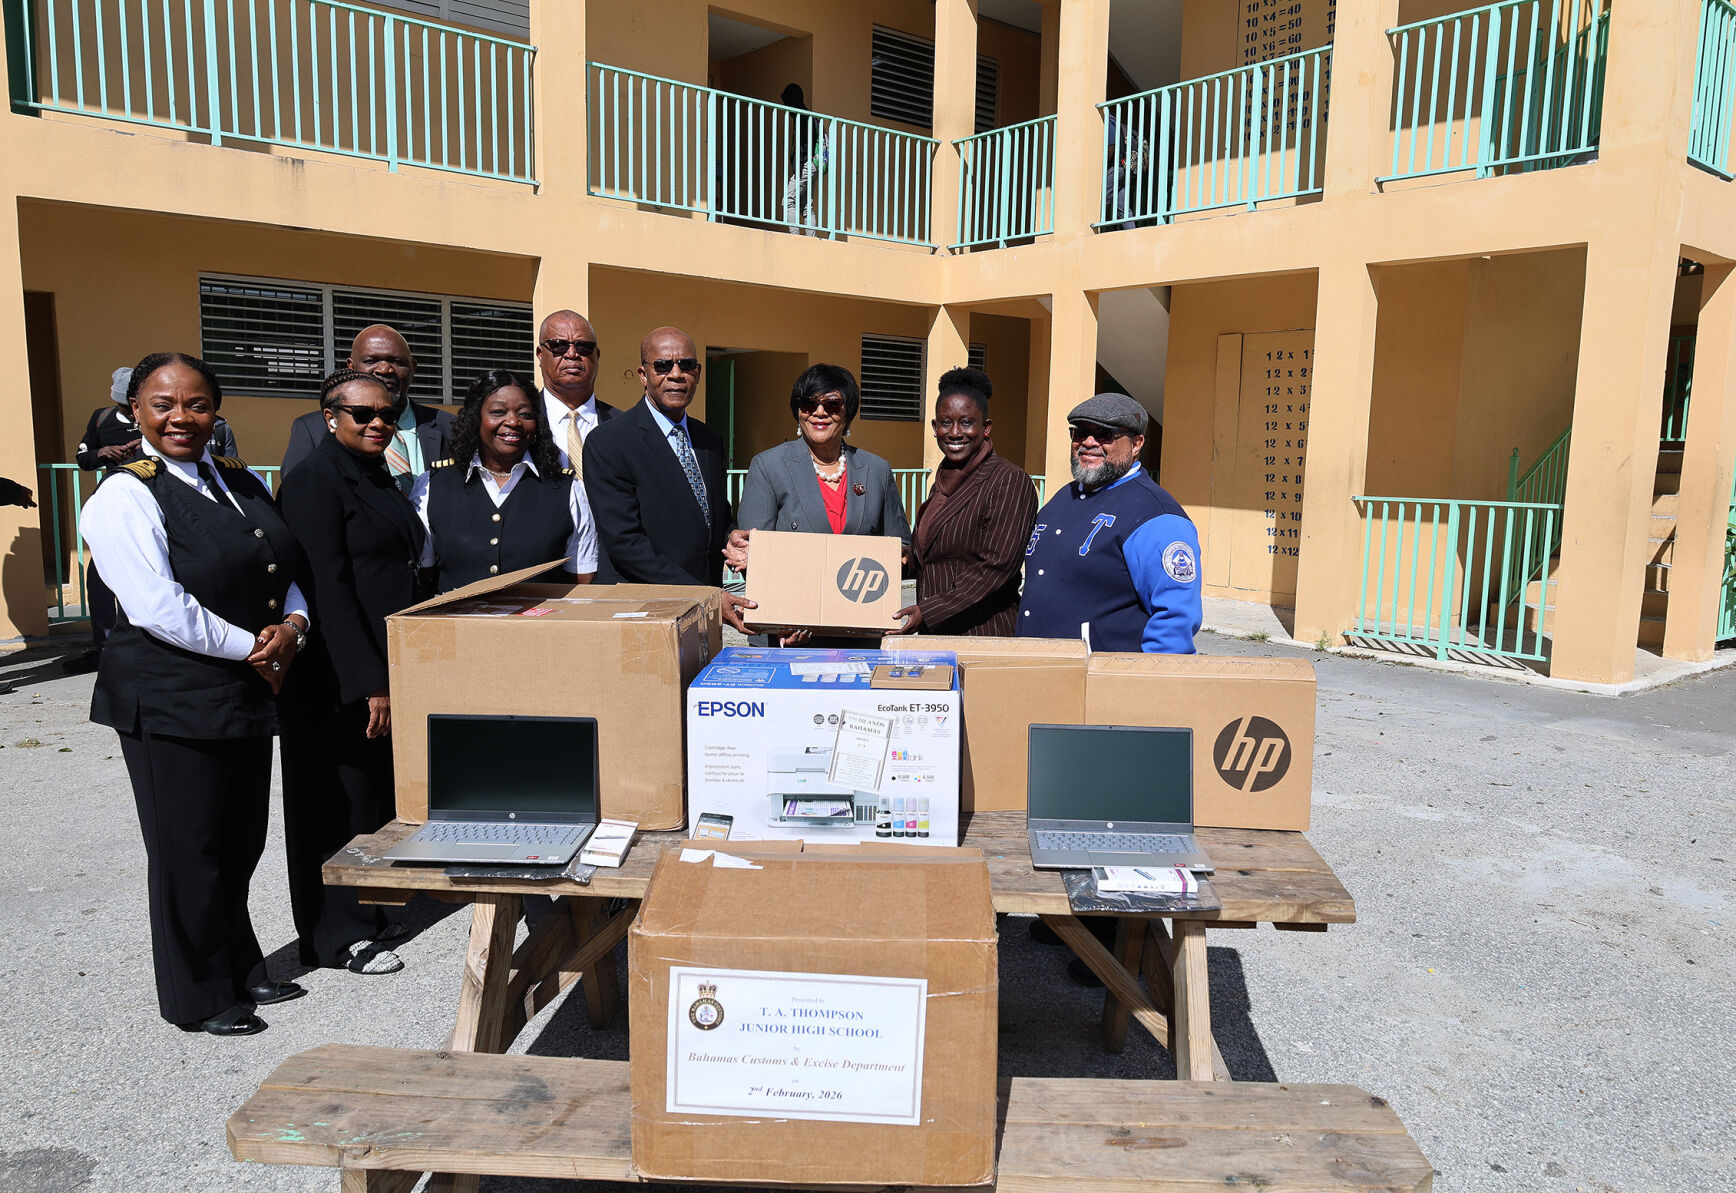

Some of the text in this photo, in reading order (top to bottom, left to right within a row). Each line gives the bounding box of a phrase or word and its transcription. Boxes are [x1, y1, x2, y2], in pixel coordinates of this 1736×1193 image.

[1246, 17, 1258, 28] 10
[1245, 32, 1258, 43] 10
[1244, 46, 1257, 58] 10
[1303, 349, 1309, 360] 1
[1266, 369, 1281, 379] 12
[1300, 367, 1307, 377] 2
[1266, 386, 1280, 396] 12
[1300, 385, 1306, 395] 3
[1265, 404, 1278, 414] 12
[1299, 403, 1306, 413] 4
[1265, 421, 1278, 431] 12
[1299, 421, 1305, 431] 5
[1264, 438, 1276, 448] 12
[1297, 439, 1304, 448] 6
[1264, 455, 1276, 465] 12
[1297, 456, 1304, 466] 7
[1264, 473, 1276, 482] 12
[1295, 474, 1302, 484] 8
[1264, 491, 1275, 500] 12
[1294, 492, 1302, 502] 9
[1264, 509, 1275, 519] 12
[1290, 511, 1302, 521] 10
[1079, 512, 1117, 557] T
[1266, 527, 1278, 536] 12
[1267, 544, 1279, 554] 12
[840, 557, 887, 603] hp
[698, 701, 765, 717] EPSON
[877, 703, 950, 713] EcoTank ET-3950
[1218, 715, 1288, 792] hp
[760, 1006, 864, 1021] T. A. THOMPSON
[739, 1022, 883, 1039] JUNIOR HIGH SCHOOL
[688, 1052, 906, 1073] Bahamas Customs & Excise Department
[818, 1089, 843, 1100] 2026
